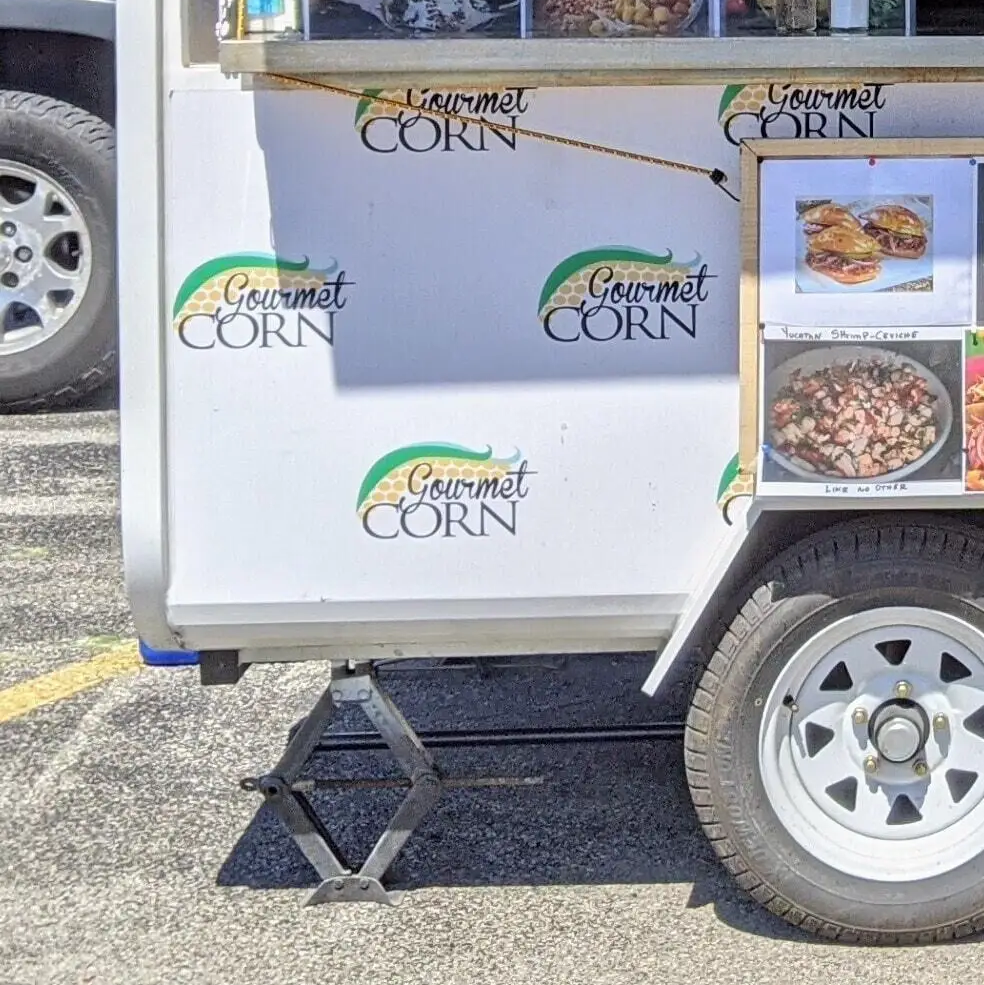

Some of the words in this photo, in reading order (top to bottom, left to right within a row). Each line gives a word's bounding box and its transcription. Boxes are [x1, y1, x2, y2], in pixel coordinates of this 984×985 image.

[361, 115, 520, 153] CORN
[724, 111, 877, 146] CORN
[216, 271, 356, 324] Gourmet
[580, 264, 718, 317] Gourmet
[178, 311, 340, 350] CORN
[543, 304, 700, 342] CORN
[399, 460, 538, 514] Gourmet
[362, 500, 519, 539] CORN
